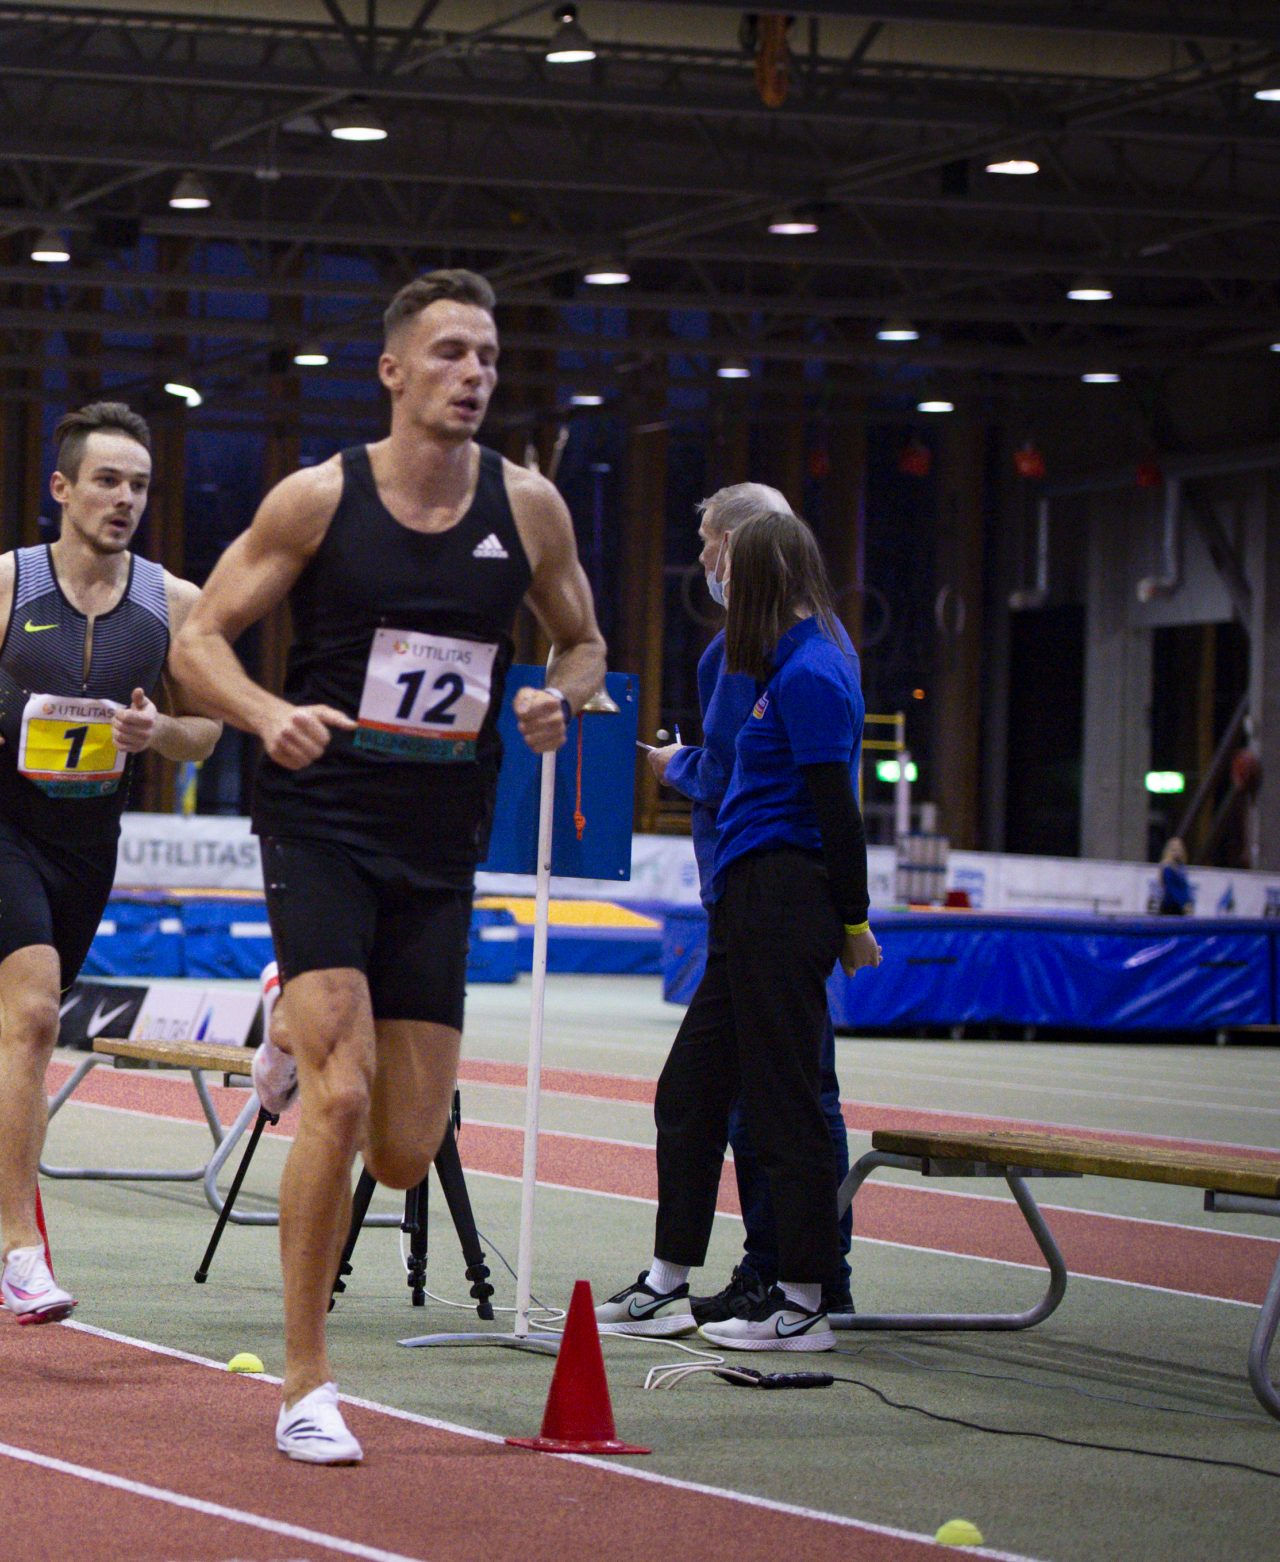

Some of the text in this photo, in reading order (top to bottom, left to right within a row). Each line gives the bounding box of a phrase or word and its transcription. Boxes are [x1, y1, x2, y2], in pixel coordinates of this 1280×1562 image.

[412, 643, 472, 664] UTILITAS
[58, 704, 115, 717] UTILITAS
[395, 669, 464, 725] 12
[63, 725, 89, 769] 1
[122, 839, 257, 868] UTILITAS
